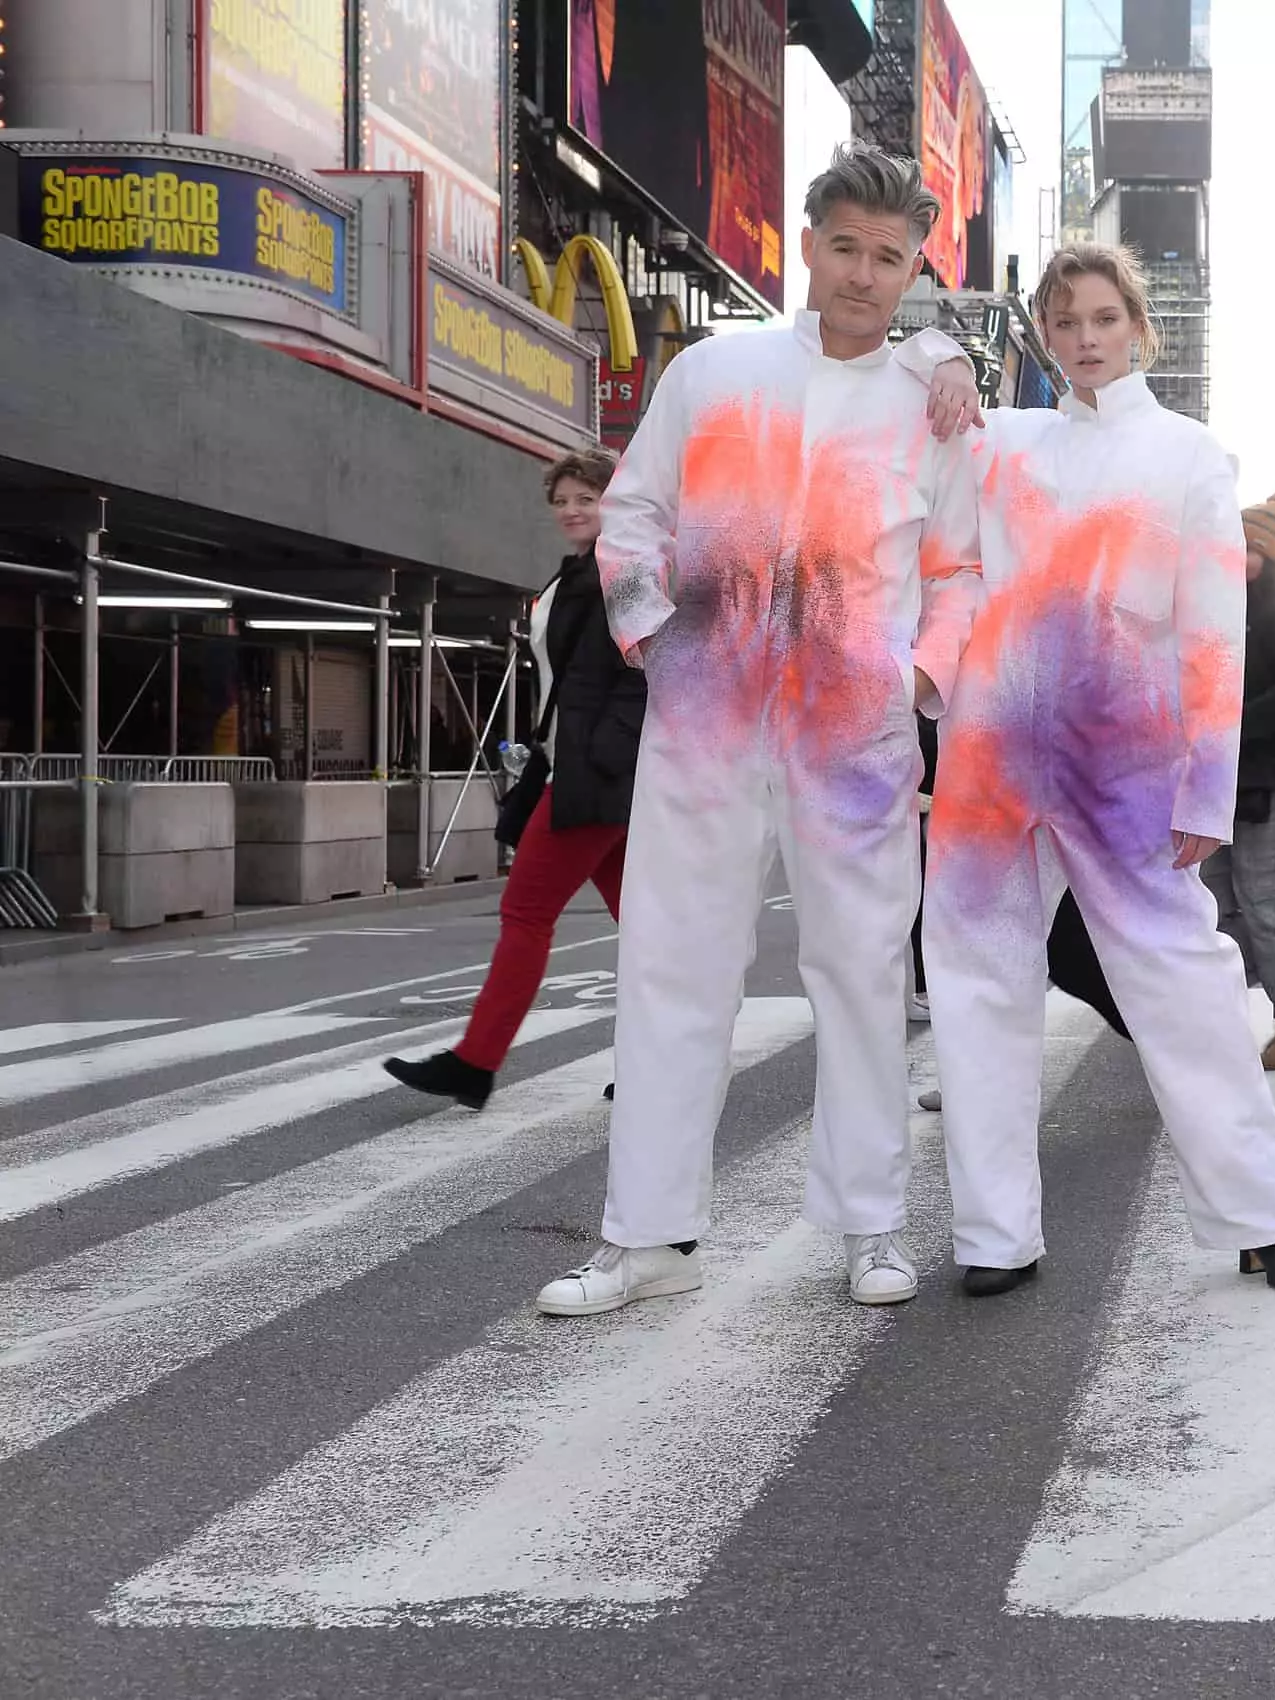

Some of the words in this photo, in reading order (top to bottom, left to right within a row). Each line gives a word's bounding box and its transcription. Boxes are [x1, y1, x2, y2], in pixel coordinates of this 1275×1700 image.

[44, 168, 219, 225] SPONGEBOB
[44, 216, 220, 256] SQUAREPANTS
[256, 187, 334, 265] SPONGEBOB
